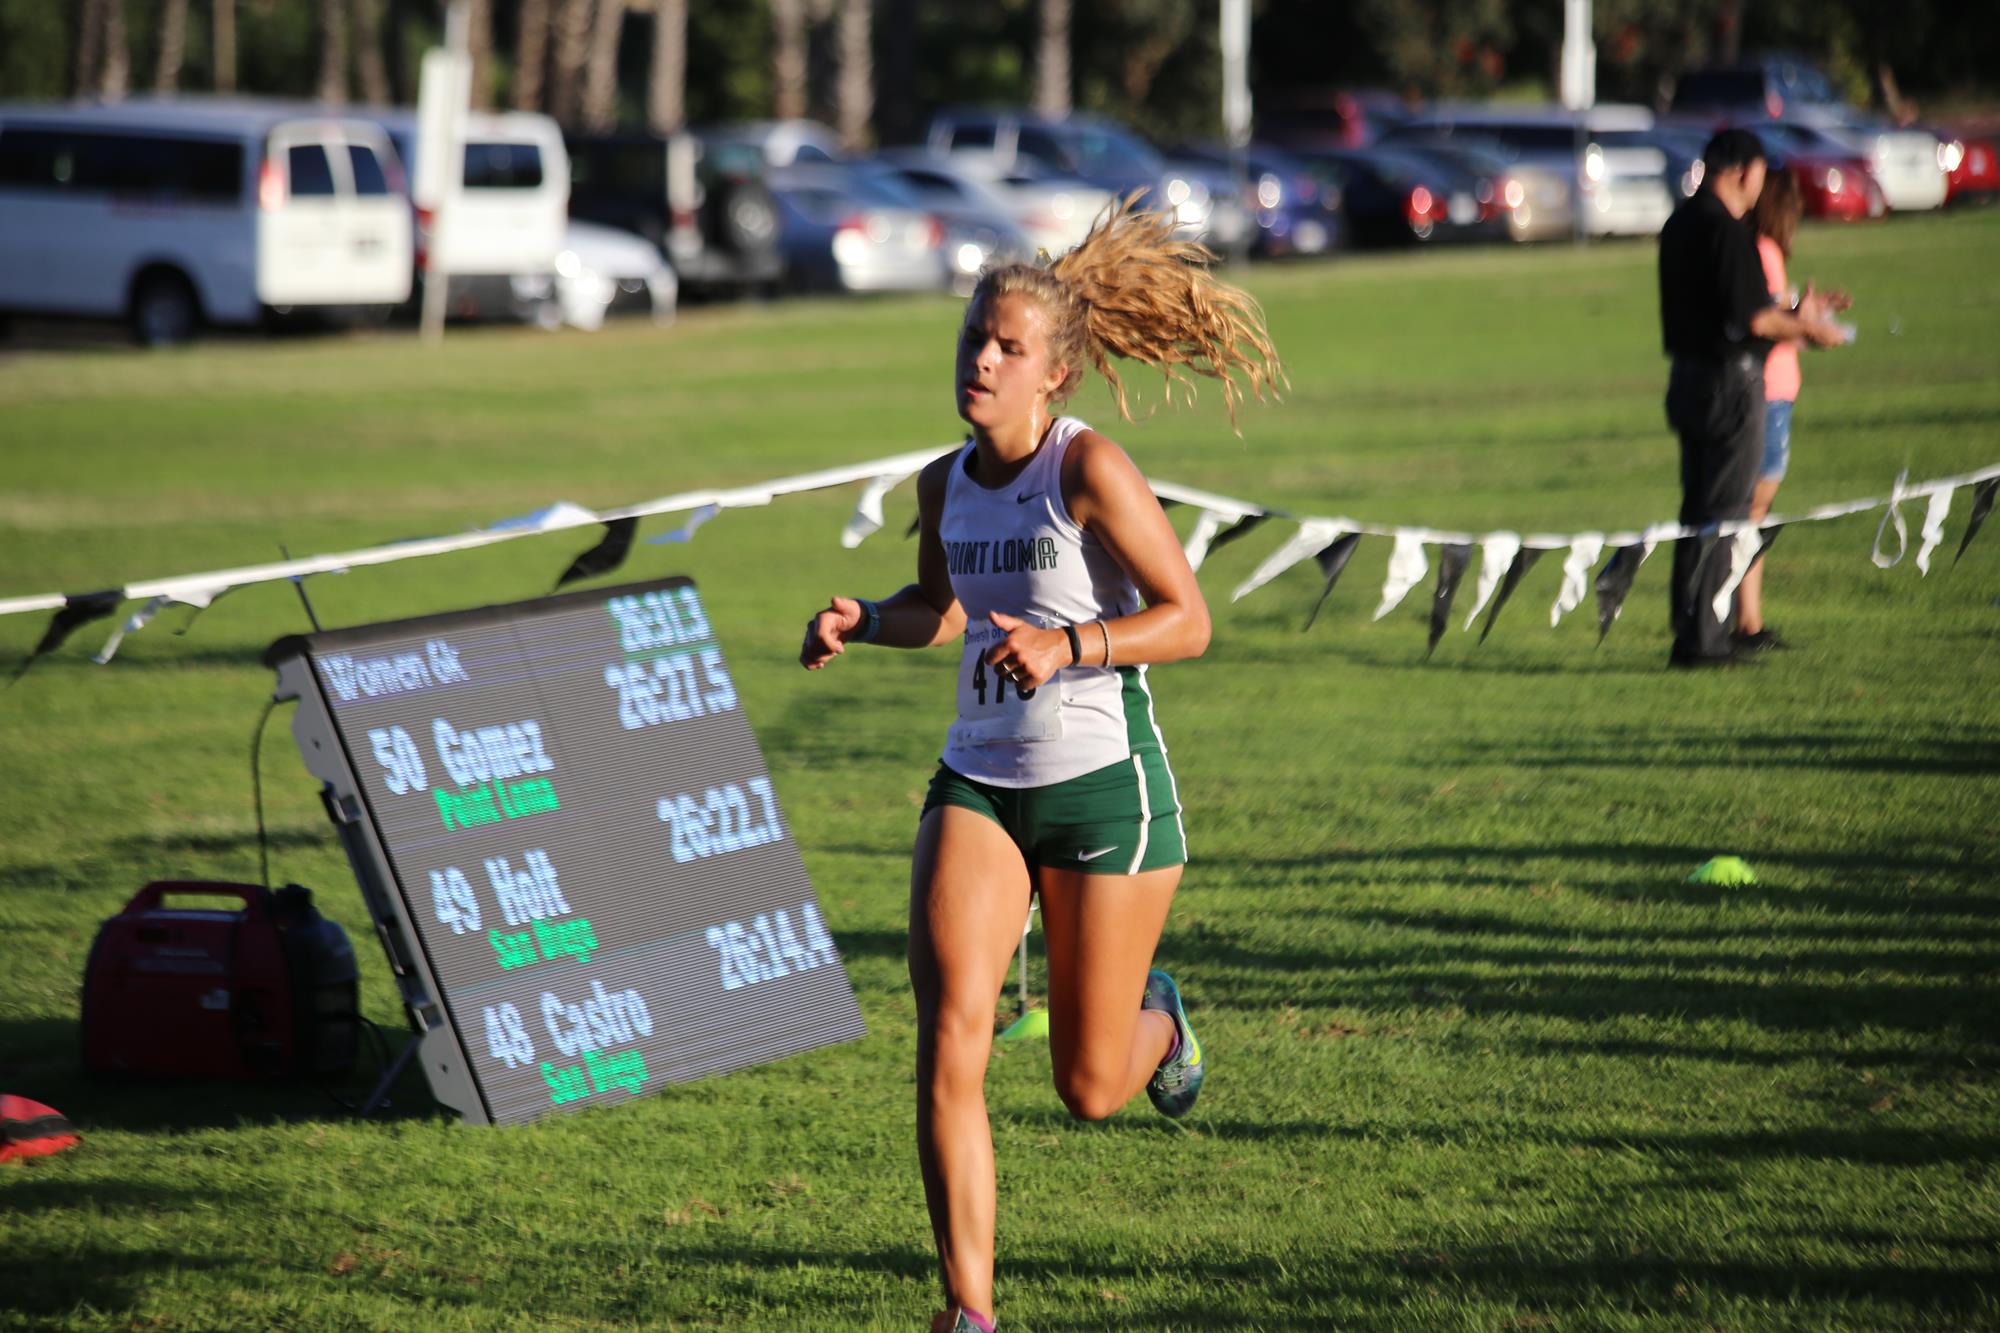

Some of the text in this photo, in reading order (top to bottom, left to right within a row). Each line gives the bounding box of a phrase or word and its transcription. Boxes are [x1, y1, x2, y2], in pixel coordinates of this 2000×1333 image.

[992, 537, 1059, 574] LOMA
[367, 648, 738, 796] 50 Gomez 26:27.5
[427, 775, 785, 935] 49 Holt 26:22.7
[480, 901, 837, 1069] 48 Castro 26:14.4
